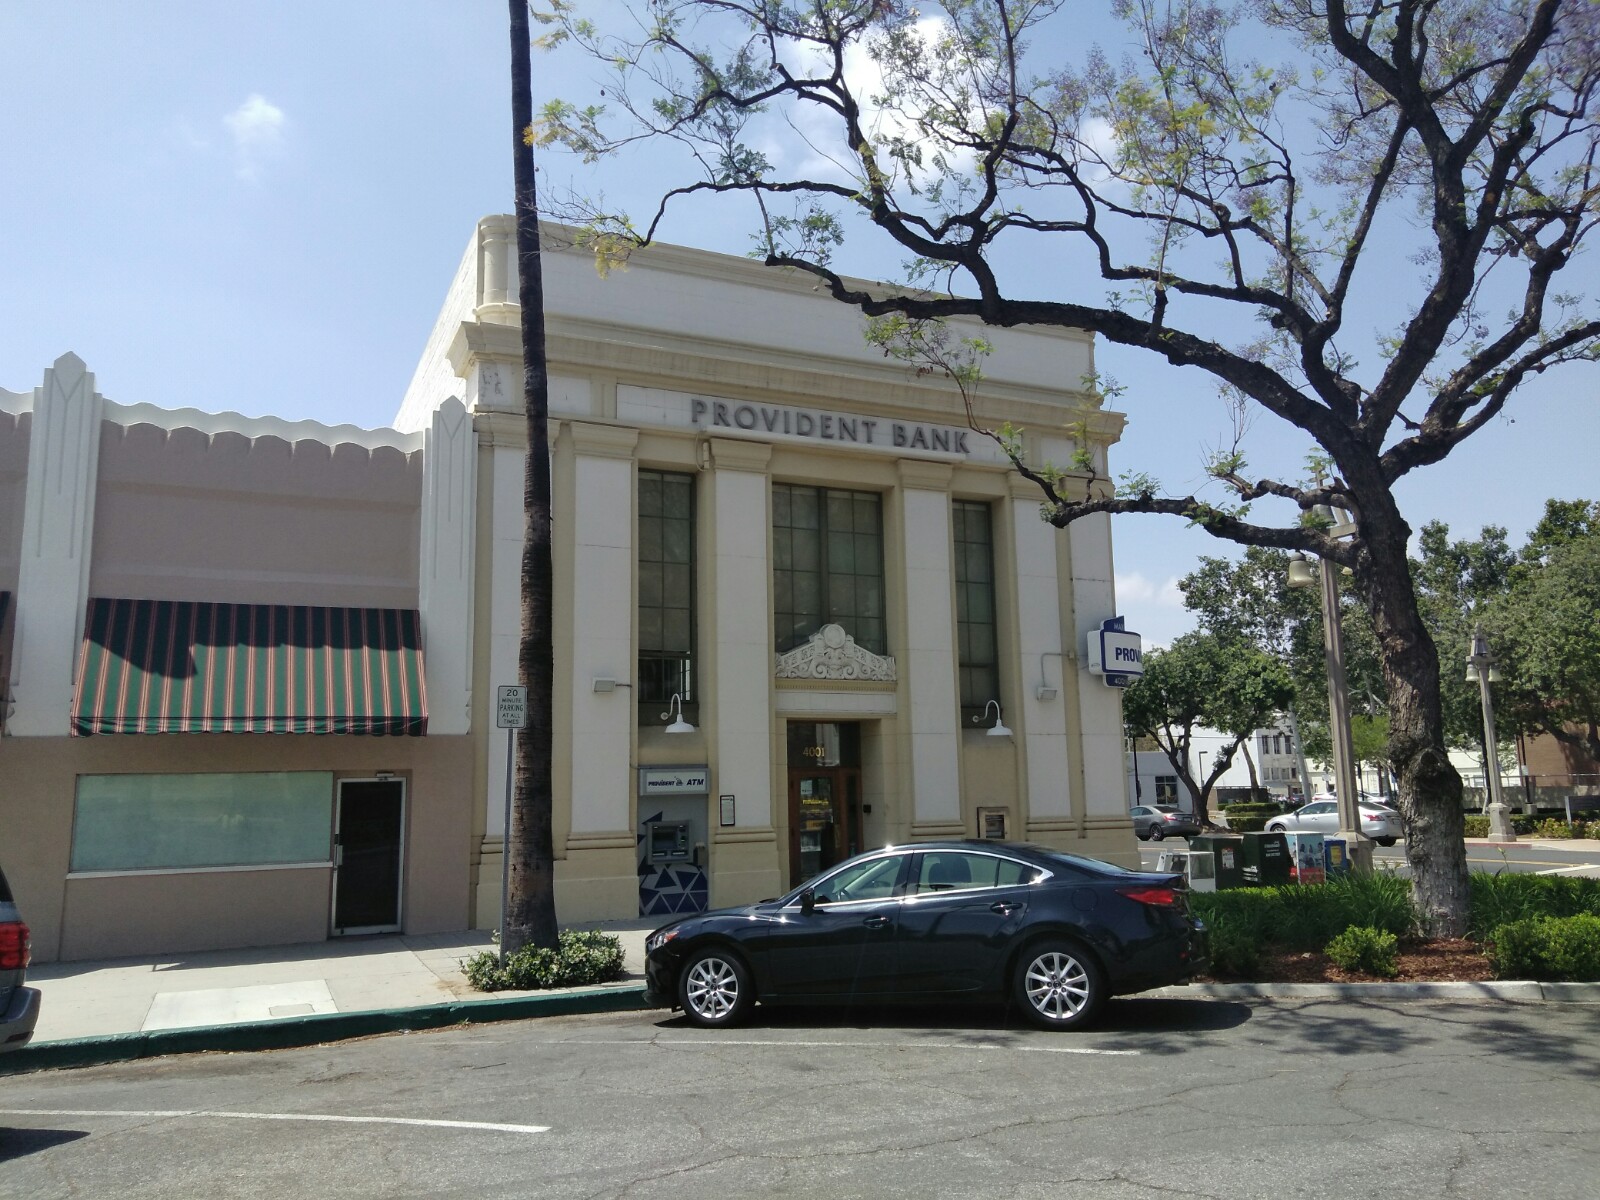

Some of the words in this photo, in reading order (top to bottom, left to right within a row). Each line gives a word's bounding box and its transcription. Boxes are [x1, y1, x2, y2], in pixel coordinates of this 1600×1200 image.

[691, 399, 877, 443] PROVIDENT
[892, 423, 971, 453] BANK
[500, 704, 523, 712] PARKING
[803, 746, 825, 757] 4001
